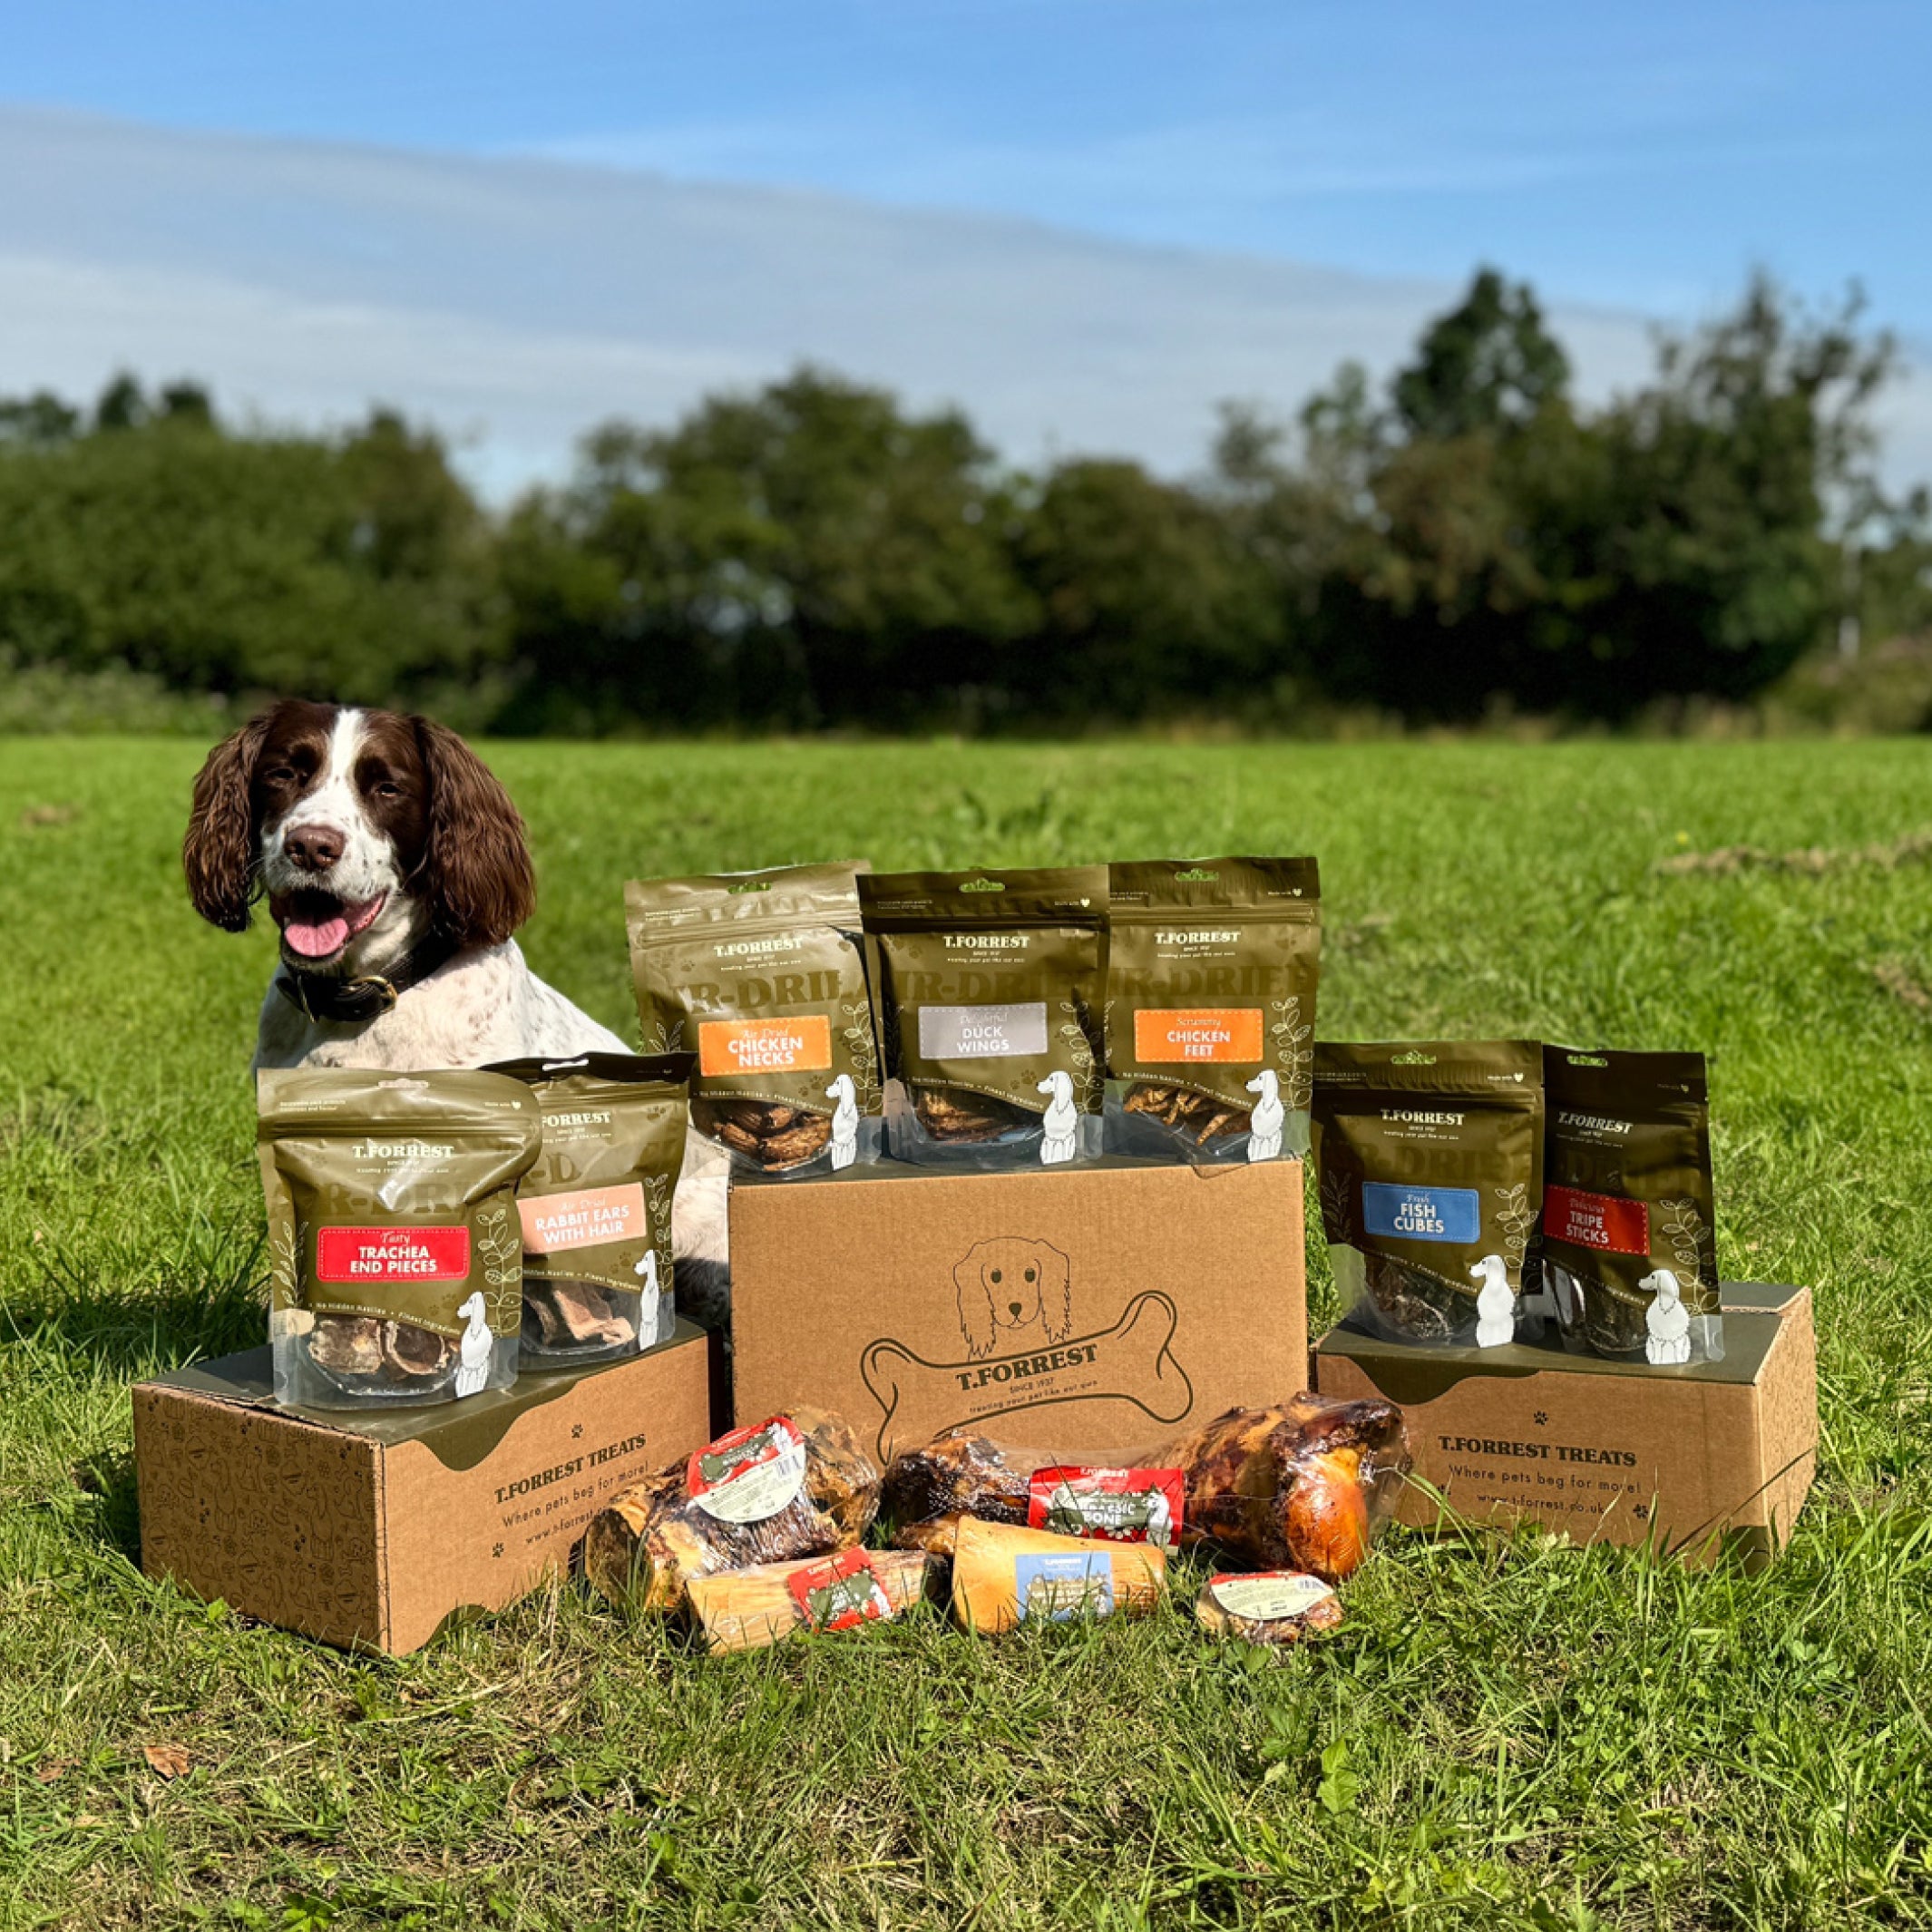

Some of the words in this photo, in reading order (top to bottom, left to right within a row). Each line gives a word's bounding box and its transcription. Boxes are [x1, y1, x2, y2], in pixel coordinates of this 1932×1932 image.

[943, 935, 1030, 949] T.FORREST
[1154, 931, 1242, 945] T.FORREST
[714, 937, 803, 958] T.FORREST
[961, 1026, 1004, 1039] DUCK
[1166, 1029, 1232, 1043] CHICKEN
[727, 1035, 804, 1054] CHICKEN
[957, 1039, 1010, 1054] WINGS
[1184, 1044, 1215, 1058] FEET
[738, 1050, 795, 1068] NECKS
[1381, 1108, 1466, 1126] T.FORREST
[1557, 1111, 1634, 1135] T.FORREST
[352, 1145, 454, 1158] T.FORREST
[535, 1211, 590, 1232] RABBIT
[593, 1205, 630, 1222] EARS
[1400, 1203, 1437, 1219] FISH
[1570, 1210, 1604, 1230] TRIPE
[543, 1226, 585, 1244] WITH
[589, 1220, 625, 1238] HAIR
[1393, 1215, 1445, 1234] CUBES
[1566, 1223, 1610, 1244] STICKS
[380, 1231, 411, 1245] Tasty
[358, 1245, 430, 1260] TRACHEA
[350, 1260, 383, 1273] END
[387, 1259, 439, 1273] PIECES
[955, 1342, 1098, 1390] T.FORREST
[1010, 1381, 1034, 1394] SINCE
[1438, 1435, 1551, 1459] T.FORREST
[1556, 1445, 1638, 1468] TREATS
[494, 1457, 584, 1505] T.FORREST
[587, 1433, 648, 1468] TREATS
[1449, 1463, 1497, 1480] Where
[1501, 1472, 1532, 1485] pets
[1537, 1471, 1566, 1490] beg
[1570, 1474, 1592, 1488] for
[1597, 1480, 1642, 1495] more!
[502, 1507, 541, 1529] Where
[545, 1496, 570, 1516] pets
[573, 1484, 596, 1502] beg
[598, 1476, 614, 1491] for
[617, 1459, 649, 1482] more!
